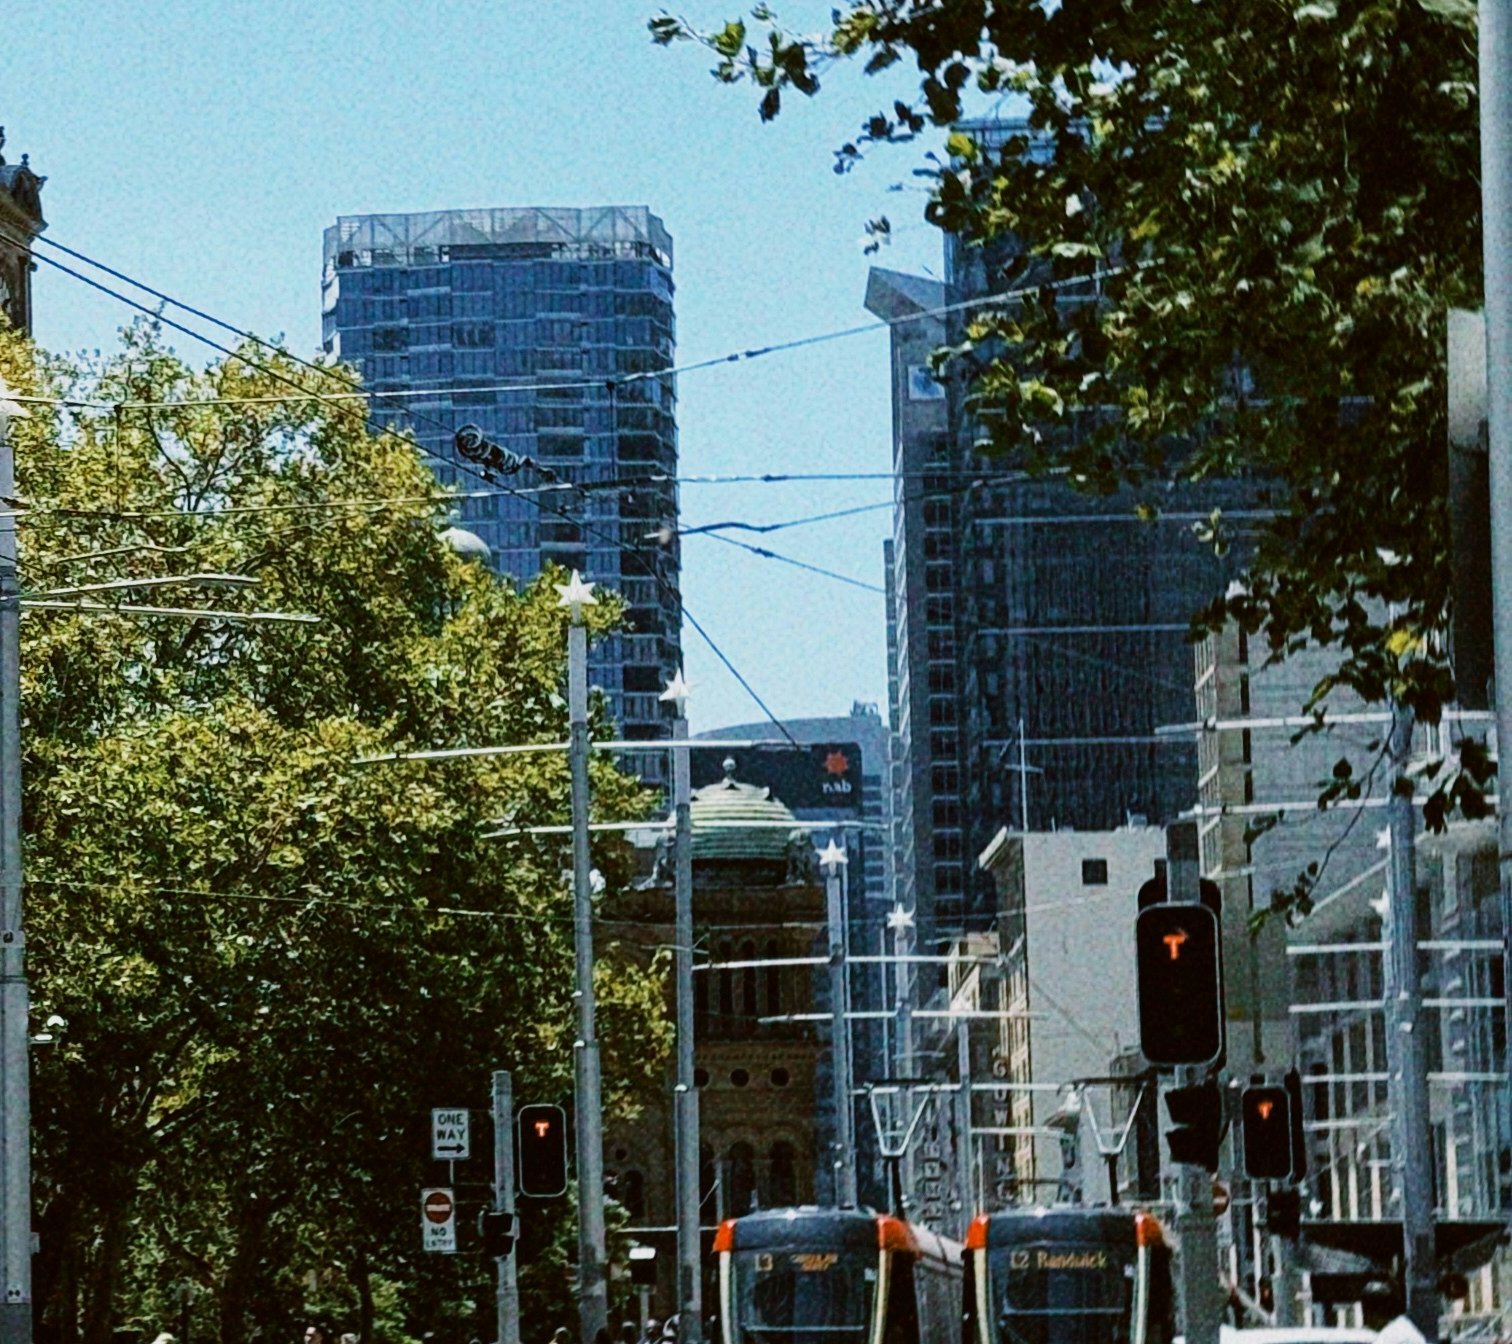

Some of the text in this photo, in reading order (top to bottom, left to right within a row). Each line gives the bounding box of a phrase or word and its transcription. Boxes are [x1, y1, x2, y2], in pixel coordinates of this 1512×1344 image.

[822, 778, 852, 794] nab
[437, 1112, 464, 1126] ONE
[436, 1128, 466, 1141] WAY
[431, 1226, 448, 1237] NO
[754, 1253, 774, 1271] L3
[1010, 1250, 1030, 1269] L2
